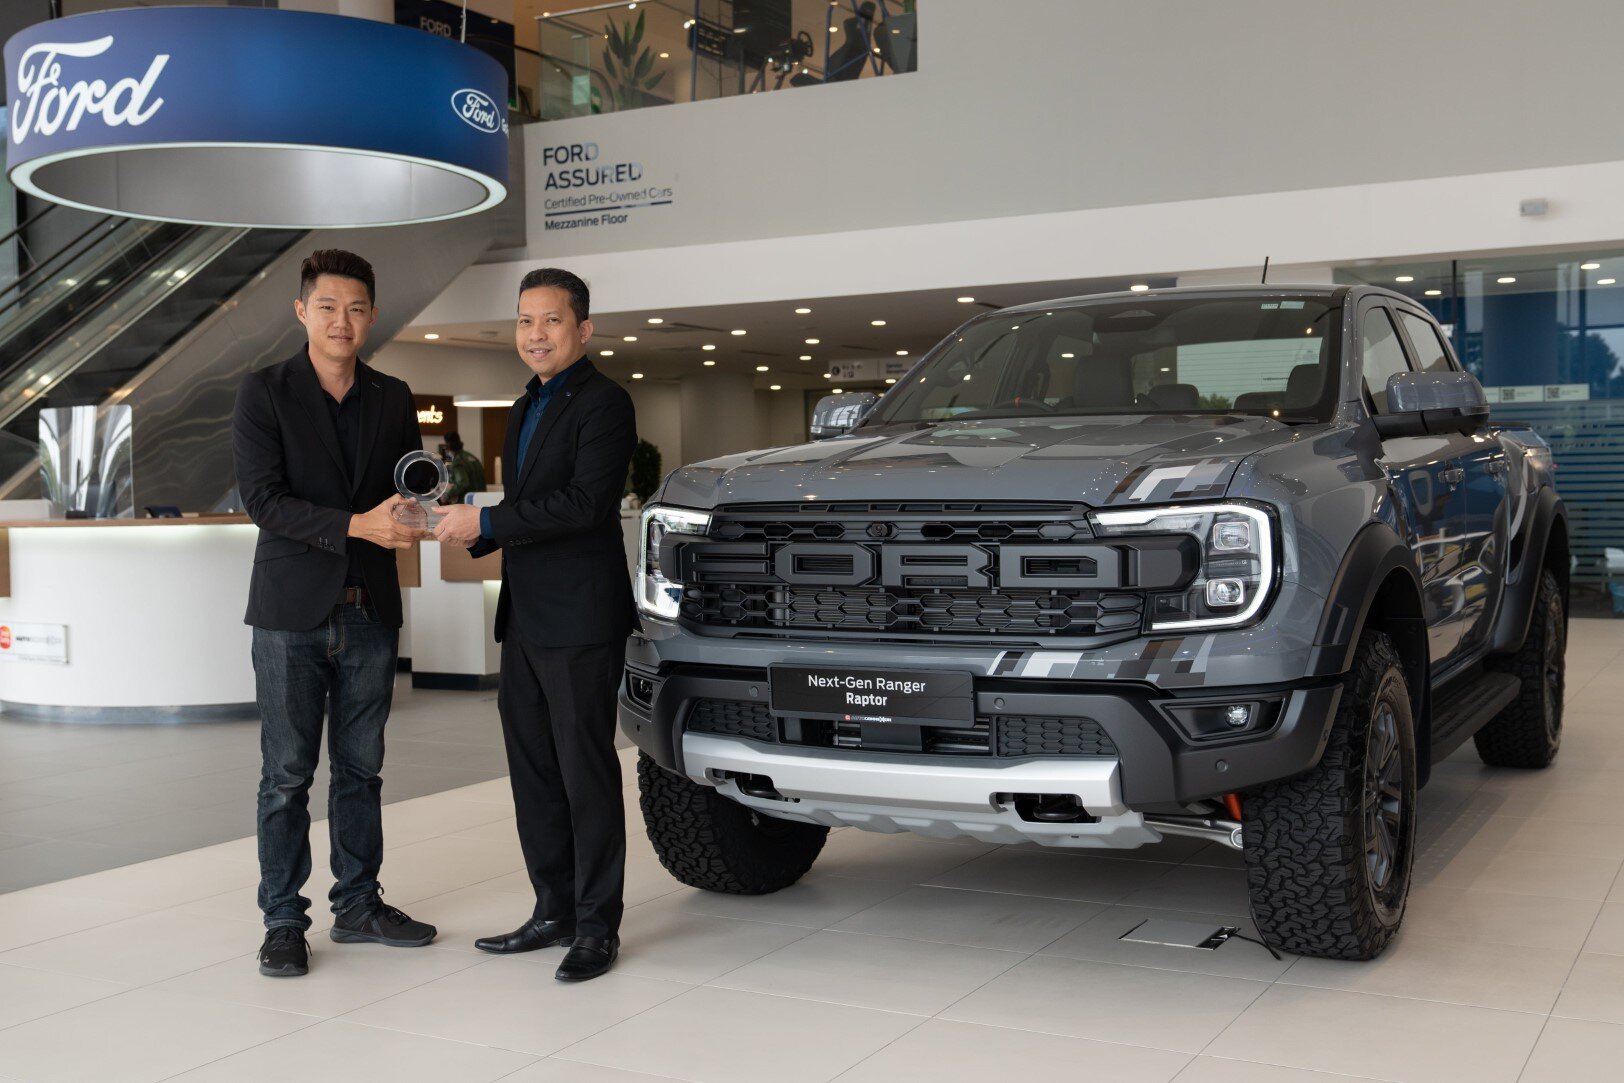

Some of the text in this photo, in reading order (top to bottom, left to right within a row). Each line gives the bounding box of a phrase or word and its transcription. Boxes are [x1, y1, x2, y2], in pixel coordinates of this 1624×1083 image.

[420, 16, 451, 37] FORD
[12, 35, 170, 144] Ford
[462, 93, 495, 128] Ford
[543, 142, 599, 166] FORD
[544, 162, 643, 190] ASSURED
[544, 187, 673, 210] Certified Pre-Owned Cars
[544, 213, 628, 231] Mezzanine Floor
[690, 540, 1120, 590] FORD
[807, 674, 926, 694] Next-Gen Ranger
[846, 692, 888, 707] Raptor
